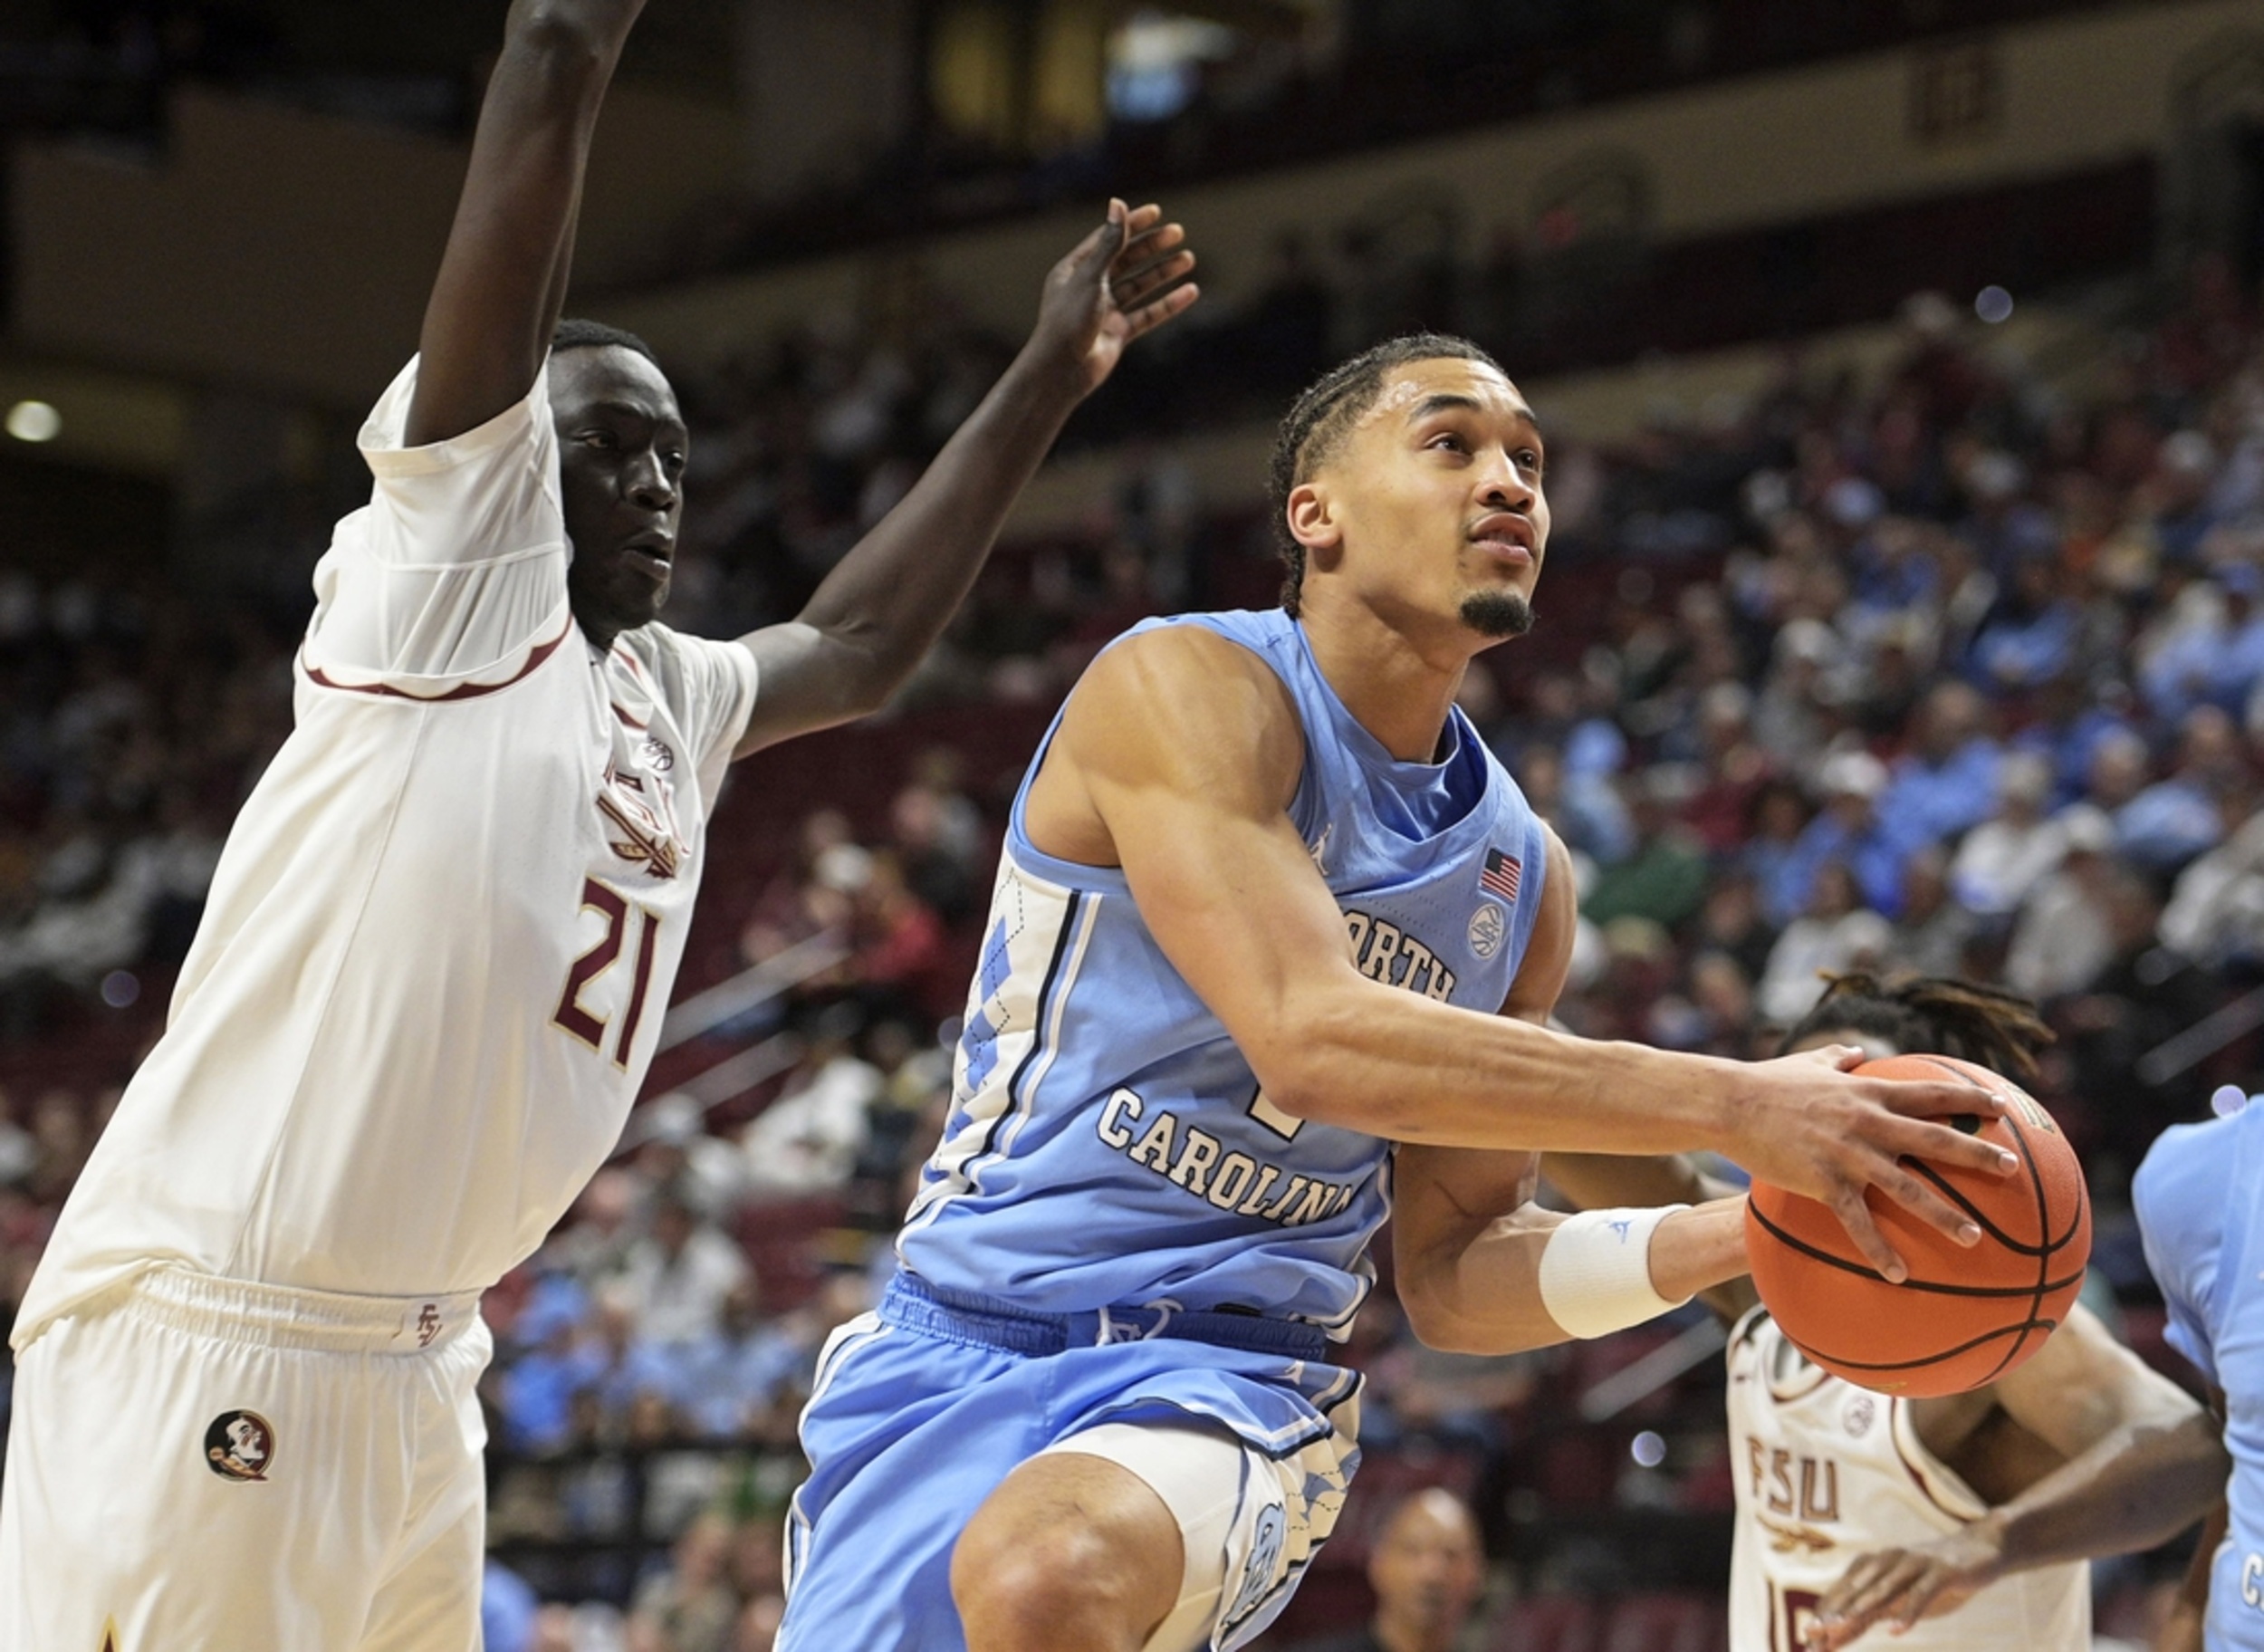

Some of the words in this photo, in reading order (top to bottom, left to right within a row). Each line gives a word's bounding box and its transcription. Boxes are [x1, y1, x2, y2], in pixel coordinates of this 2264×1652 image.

[550, 873, 664, 1073] 21
[1343, 909, 1457, 1004] ORTH
[1747, 1436, 1839, 1522] FSU
